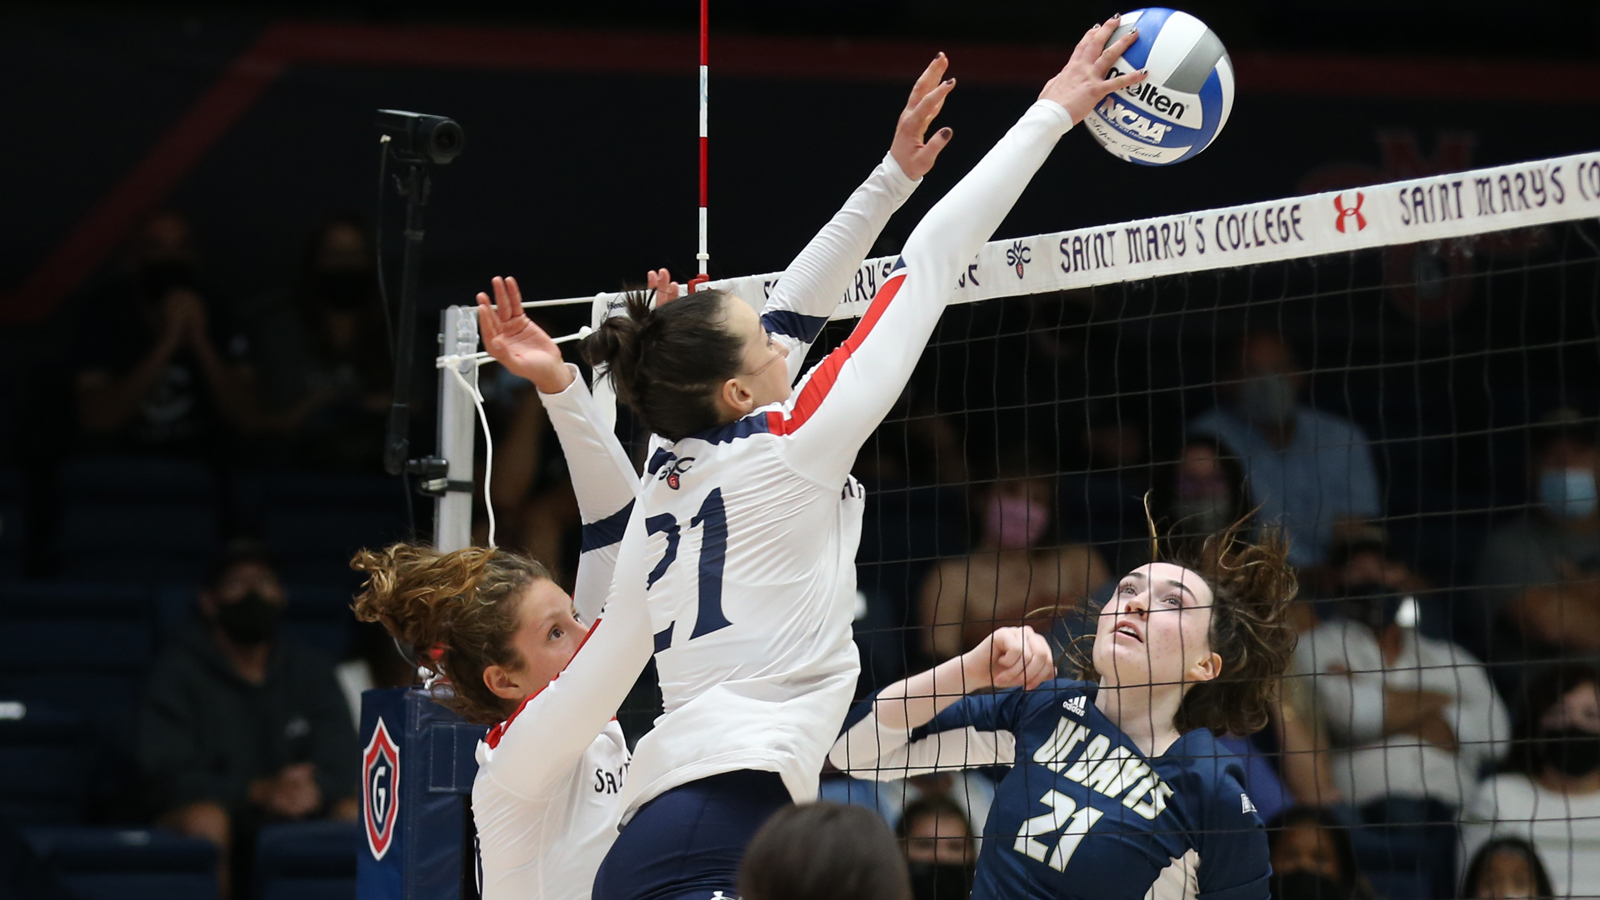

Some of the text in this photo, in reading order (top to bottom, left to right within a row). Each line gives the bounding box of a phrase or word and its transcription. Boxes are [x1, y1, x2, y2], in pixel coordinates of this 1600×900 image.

[1098, 97, 1167, 143] NCAA
[1105, 66, 1185, 120] molten
[1121, 144, 1163, 158] Touch
[1398, 181, 1464, 226] SAINT
[1475, 164, 1565, 216] MARY'S
[1059, 203, 1305, 274] SAINT MARY'S COLLEGE
[645, 486, 734, 656] 21
[1062, 700, 1086, 717] adidas
[372, 765, 386, 824] G
[1033, 715, 1175, 820] UC DAVIS
[1013, 788, 1105, 874] 21
